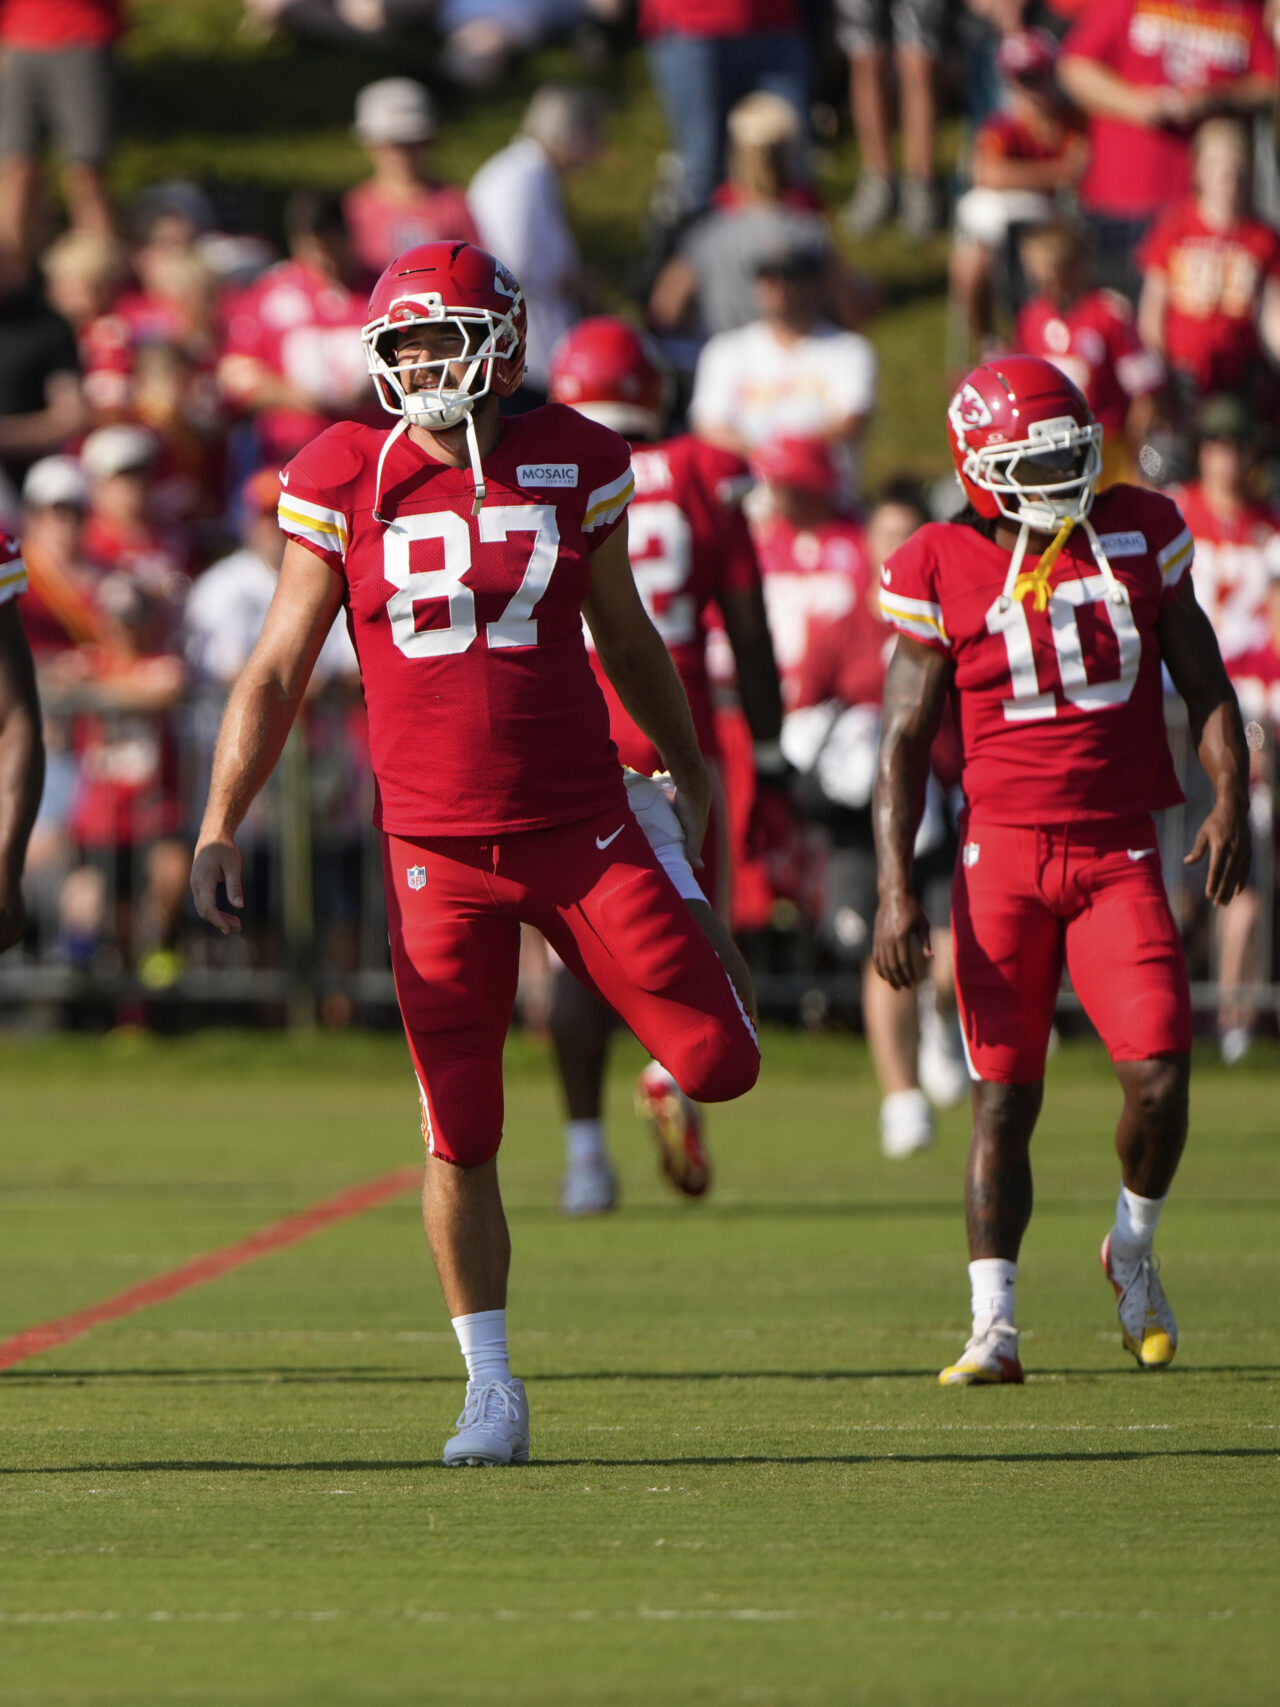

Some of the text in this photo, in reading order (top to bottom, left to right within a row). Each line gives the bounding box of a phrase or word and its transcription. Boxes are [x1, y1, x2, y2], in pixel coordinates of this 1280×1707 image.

[522, 468, 575, 479] MOSAIC
[383, 505, 561, 659] 87
[985, 574, 1143, 722] 10
